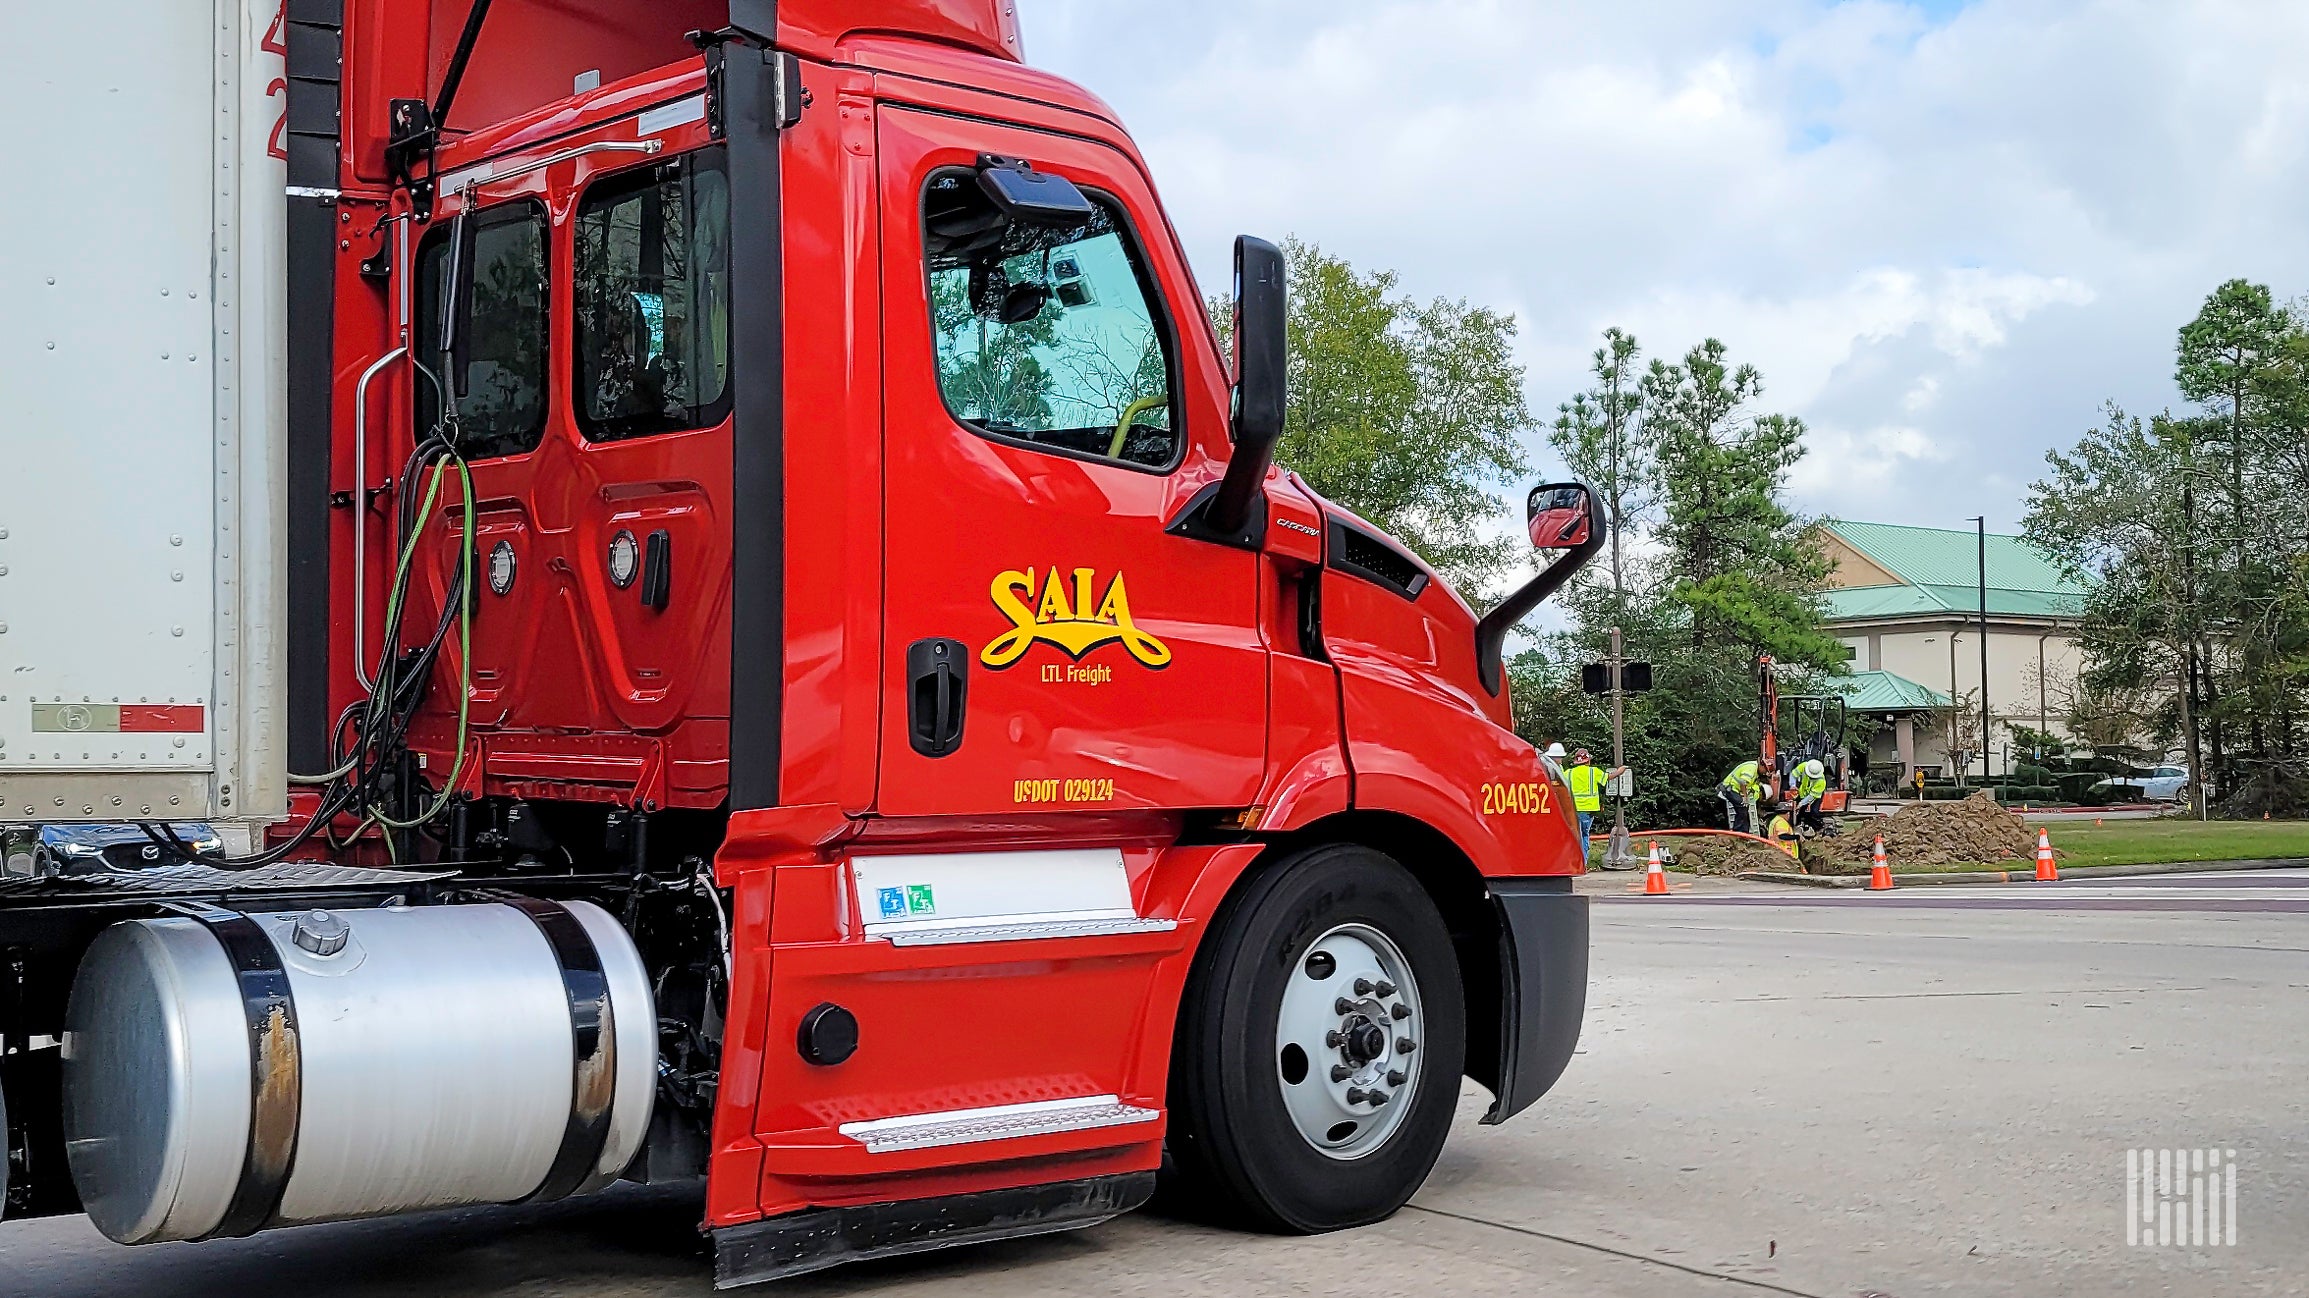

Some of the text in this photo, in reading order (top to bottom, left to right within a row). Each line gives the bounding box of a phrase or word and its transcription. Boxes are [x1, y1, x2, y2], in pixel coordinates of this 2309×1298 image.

[981, 565, 1171, 667] SAIA
[1041, 663, 1112, 686] LTL Freight
[1014, 778, 1114, 802] USDOT 029124
[1481, 783, 1550, 814] 204052
